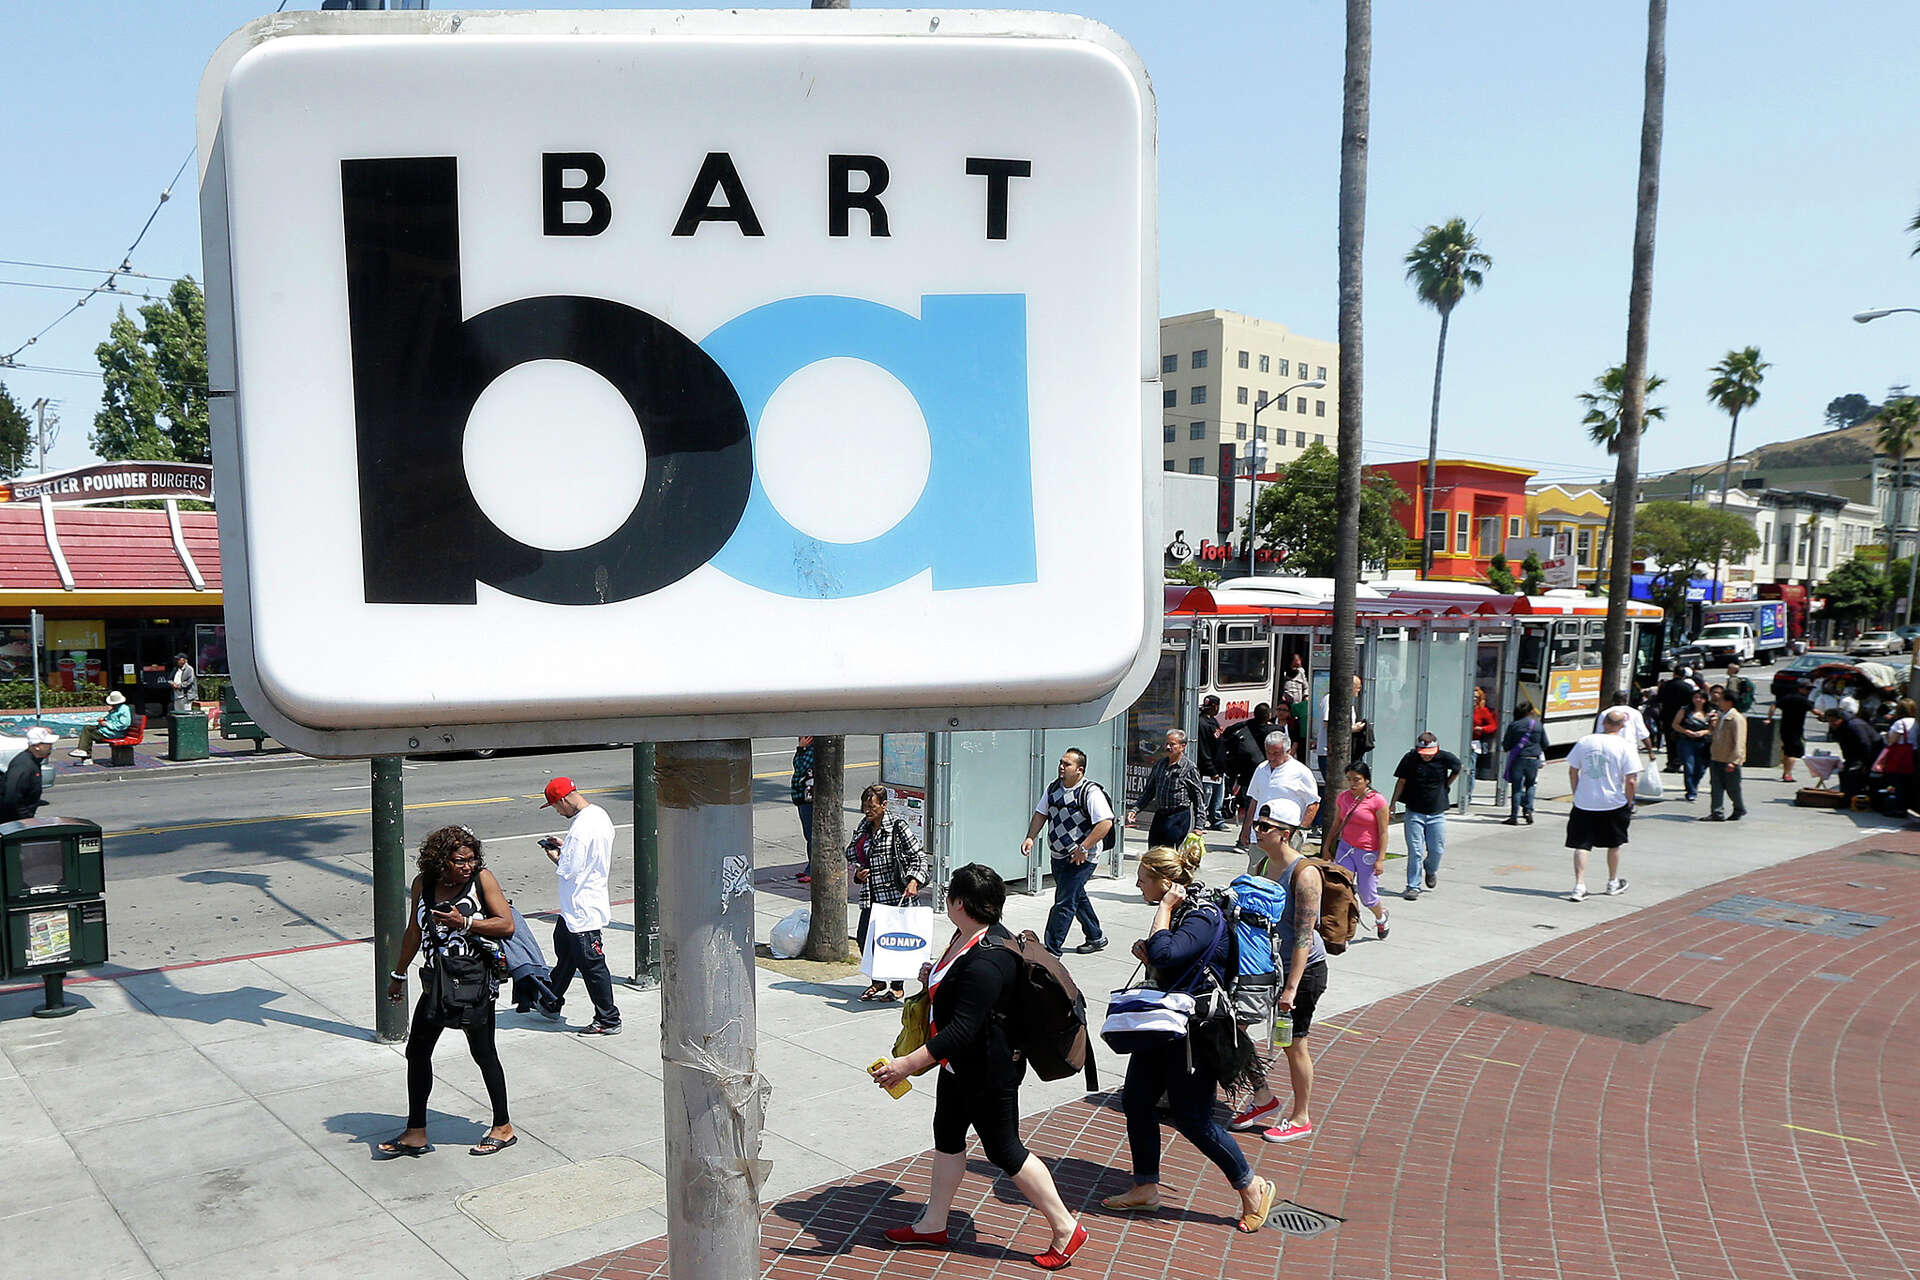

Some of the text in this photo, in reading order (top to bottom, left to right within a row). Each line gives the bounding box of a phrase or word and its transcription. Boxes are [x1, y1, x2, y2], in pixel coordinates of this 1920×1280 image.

[542, 151, 1032, 240] BART
[83, 472, 148, 492] POUNDER
[151, 472, 206, 491] BURGERS
[80, 838, 99, 848] FREE
[880, 936, 922, 948] OLD NAVY
